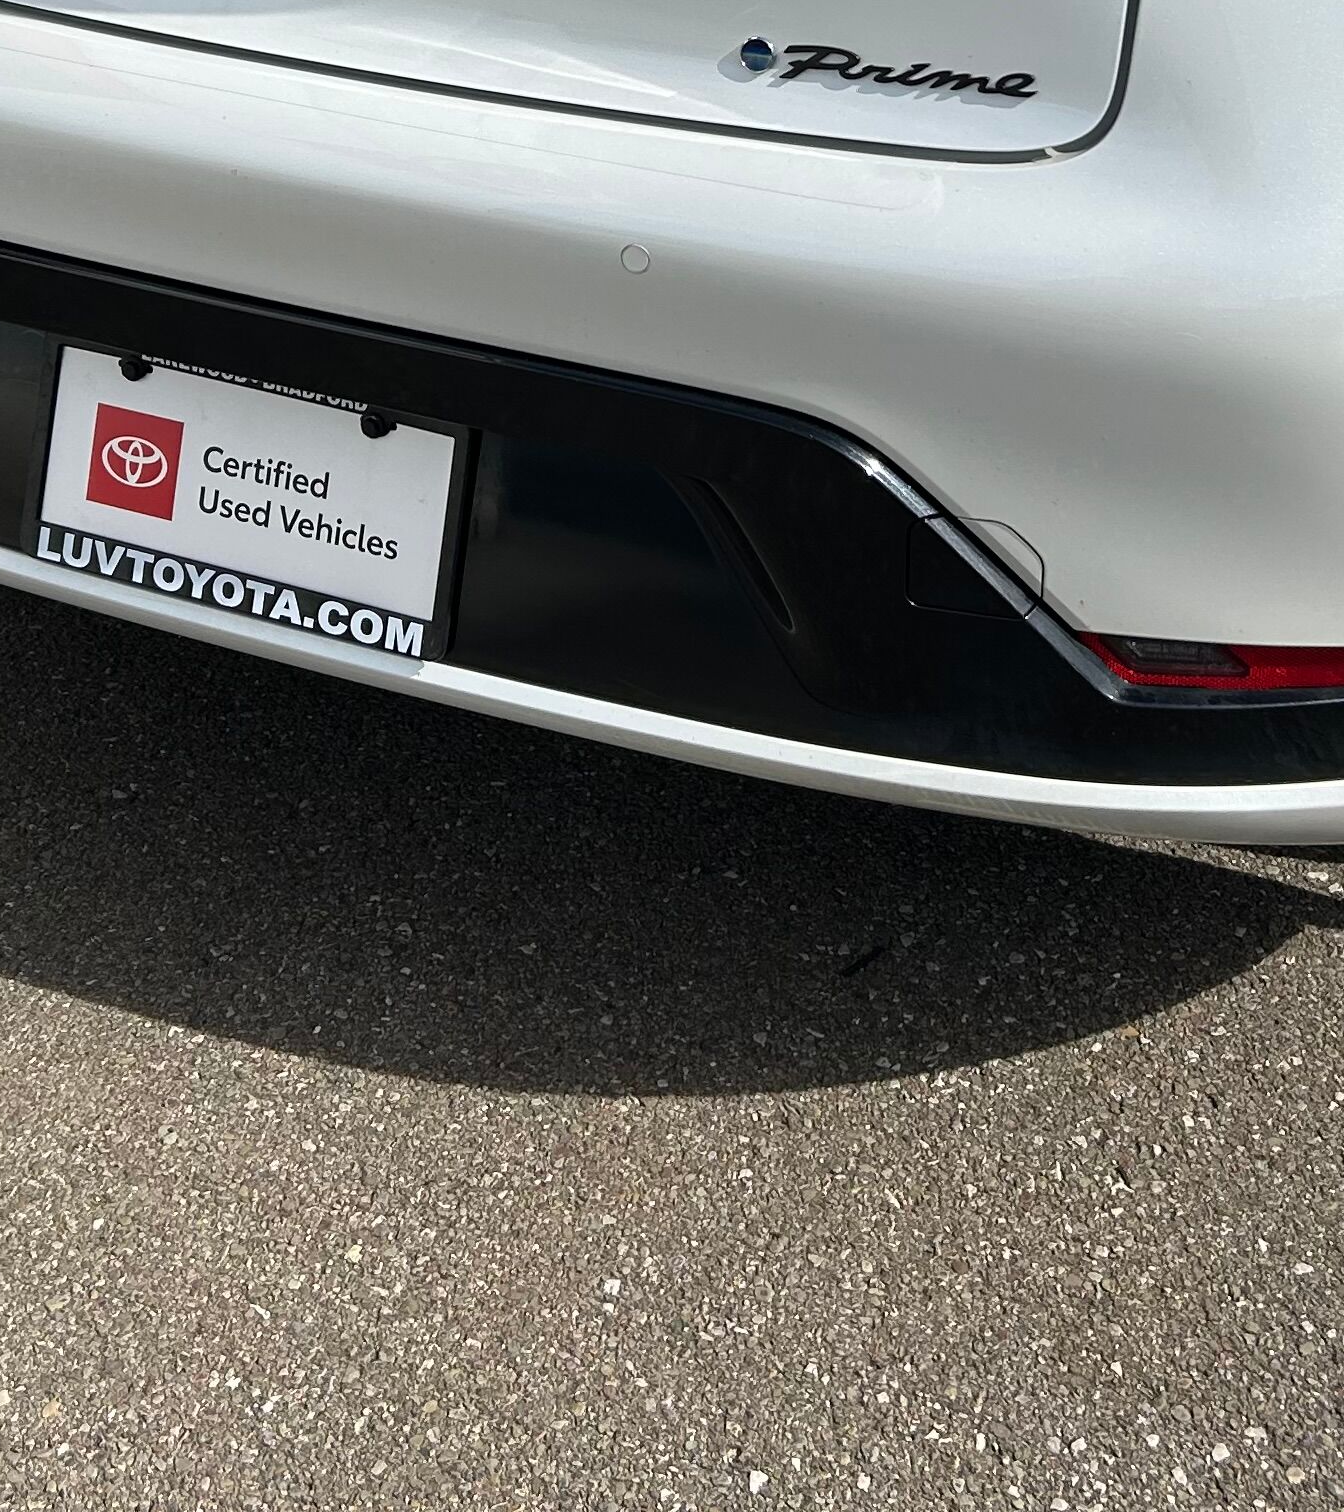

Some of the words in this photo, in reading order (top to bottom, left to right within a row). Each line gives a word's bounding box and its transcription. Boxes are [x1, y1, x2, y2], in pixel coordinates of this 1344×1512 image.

[778, 44, 1040, 99] Prime
[202, 445, 331, 500] Certified
[197, 485, 273, 529] Used
[280, 504, 400, 560] Vehicles
[36, 526, 425, 658] LUVTOYOTA.COM
